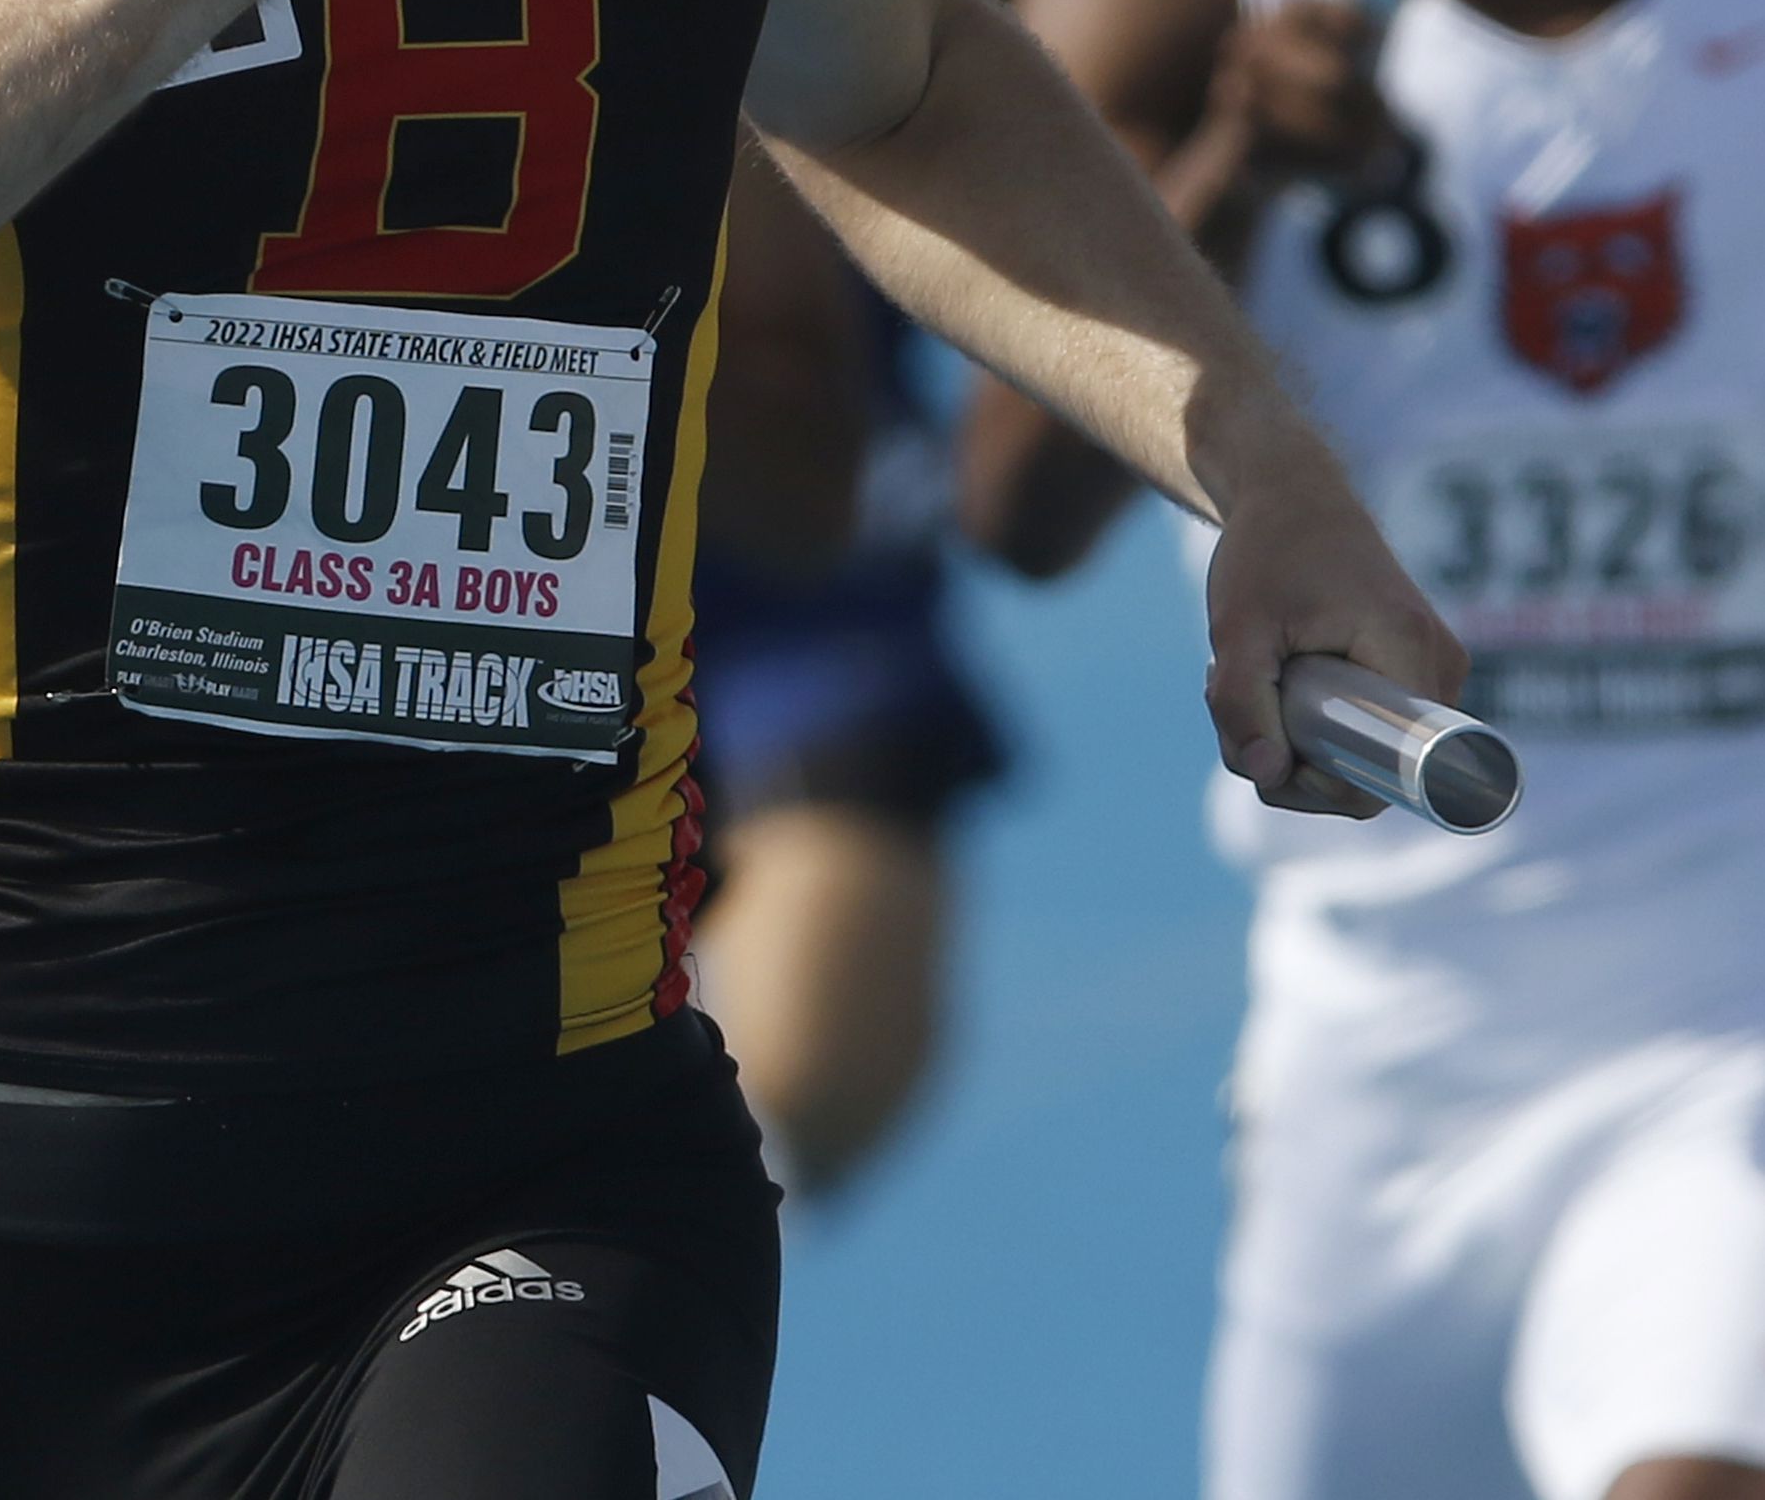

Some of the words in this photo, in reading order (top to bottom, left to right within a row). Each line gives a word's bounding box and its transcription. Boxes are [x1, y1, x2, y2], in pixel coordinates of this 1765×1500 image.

[205, 320, 265, 347] 2022
[270, 324, 322, 352] IHSA
[327, 329, 392, 357] STATE
[398, 336, 466, 365] TRACK
[469, 341, 485, 367] &
[491, 343, 547, 370] FIELD
[550, 349, 599, 374] MEET
[199, 364, 596, 561] 3043
[231, 542, 374, 602] CLASS
[386, 560, 440, 608] 3A
[455, 566, 560, 618] BOYS
[115, 639, 207, 667] Charleston,
[211, 651, 270, 674] Illinois
[131, 618, 193, 641] O'Brien
[196, 627, 264, 650] Stadium
[116, 671, 142, 686] PLAY
[204, 682, 232, 697] PLAY
[276, 634, 382, 715] IHSA
[394, 646, 536, 729] TRACK
[398, 1276, 585, 1342] adidas
